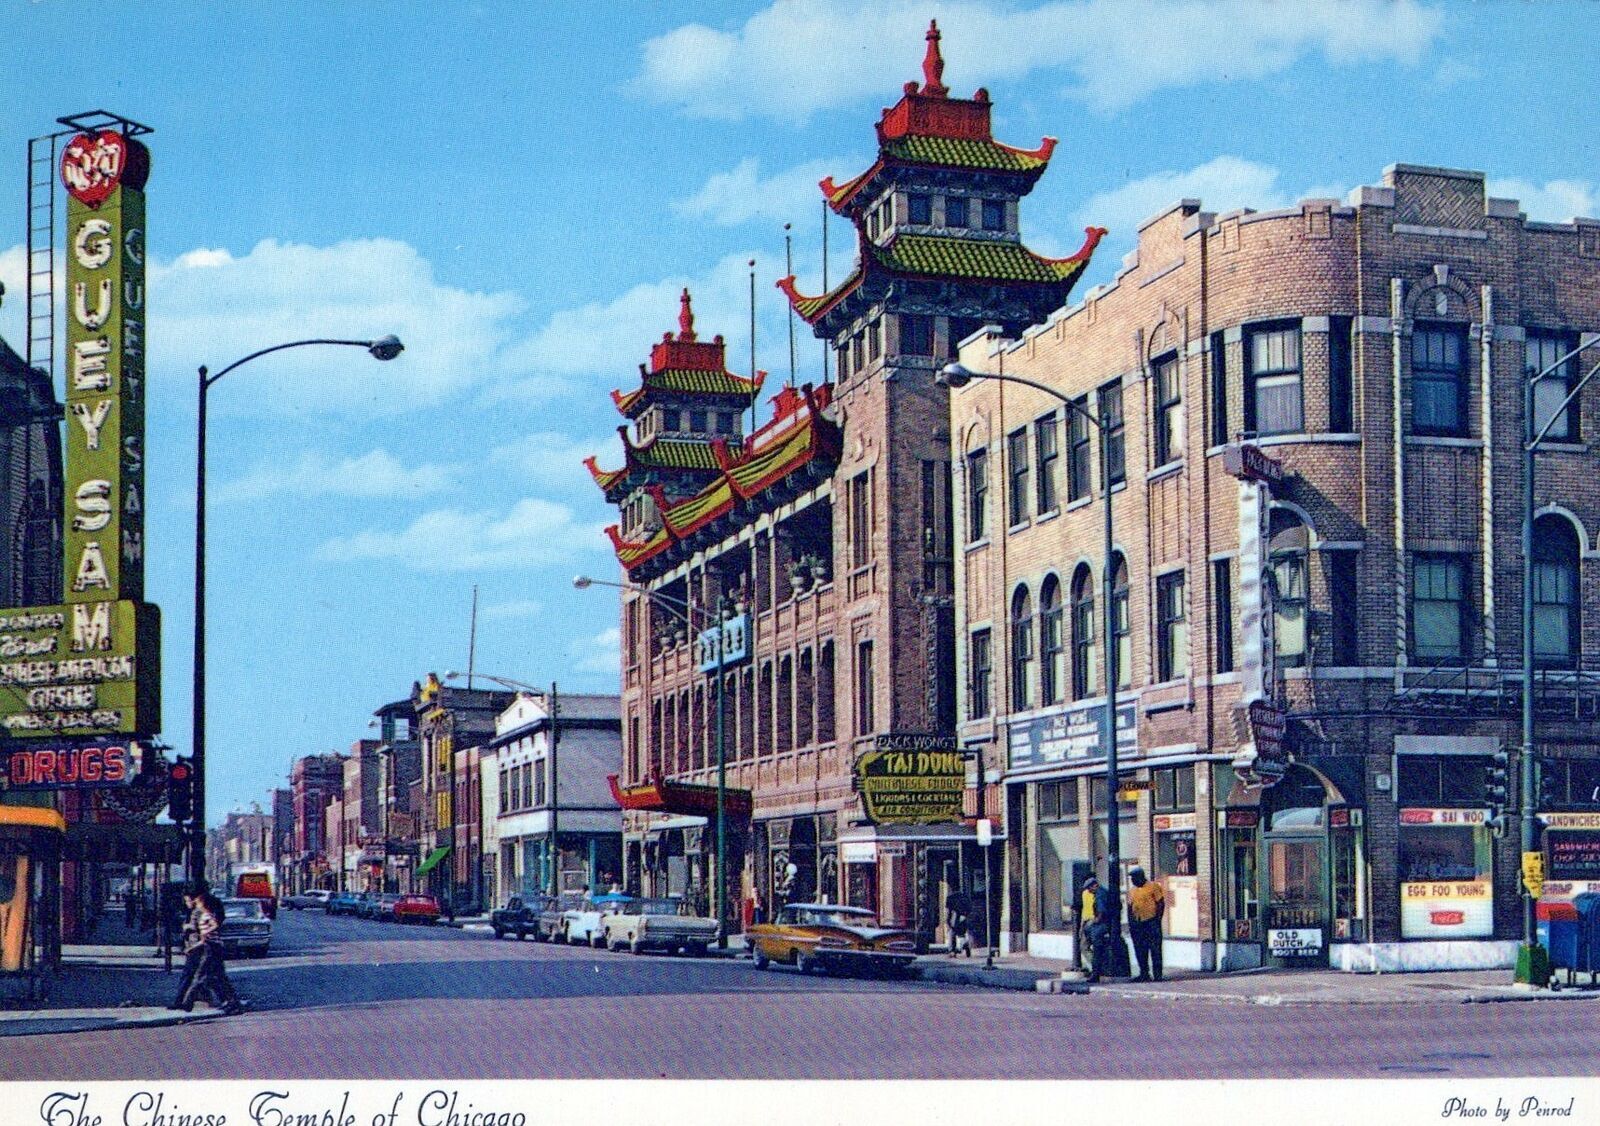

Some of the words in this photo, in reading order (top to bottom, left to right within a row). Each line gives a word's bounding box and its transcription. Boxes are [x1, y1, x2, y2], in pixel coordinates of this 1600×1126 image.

[72, 219, 112, 450] GUEY
[123, 435, 142, 563] SAM
[72, 479, 113, 652] SAM
[11, 746, 126, 784] DRUGS
[883, 752, 913, 774] TAI
[917, 752, 964, 774] DONG
[1441, 811, 1457, 822] SAI
[1463, 811, 1484, 822] WOO
[1407, 885, 1426, 896] EGG
[1432, 885, 1451, 896] FOO
[1456, 884, 1485, 896] YOUNG
[1277, 931, 1298, 939] OLD
